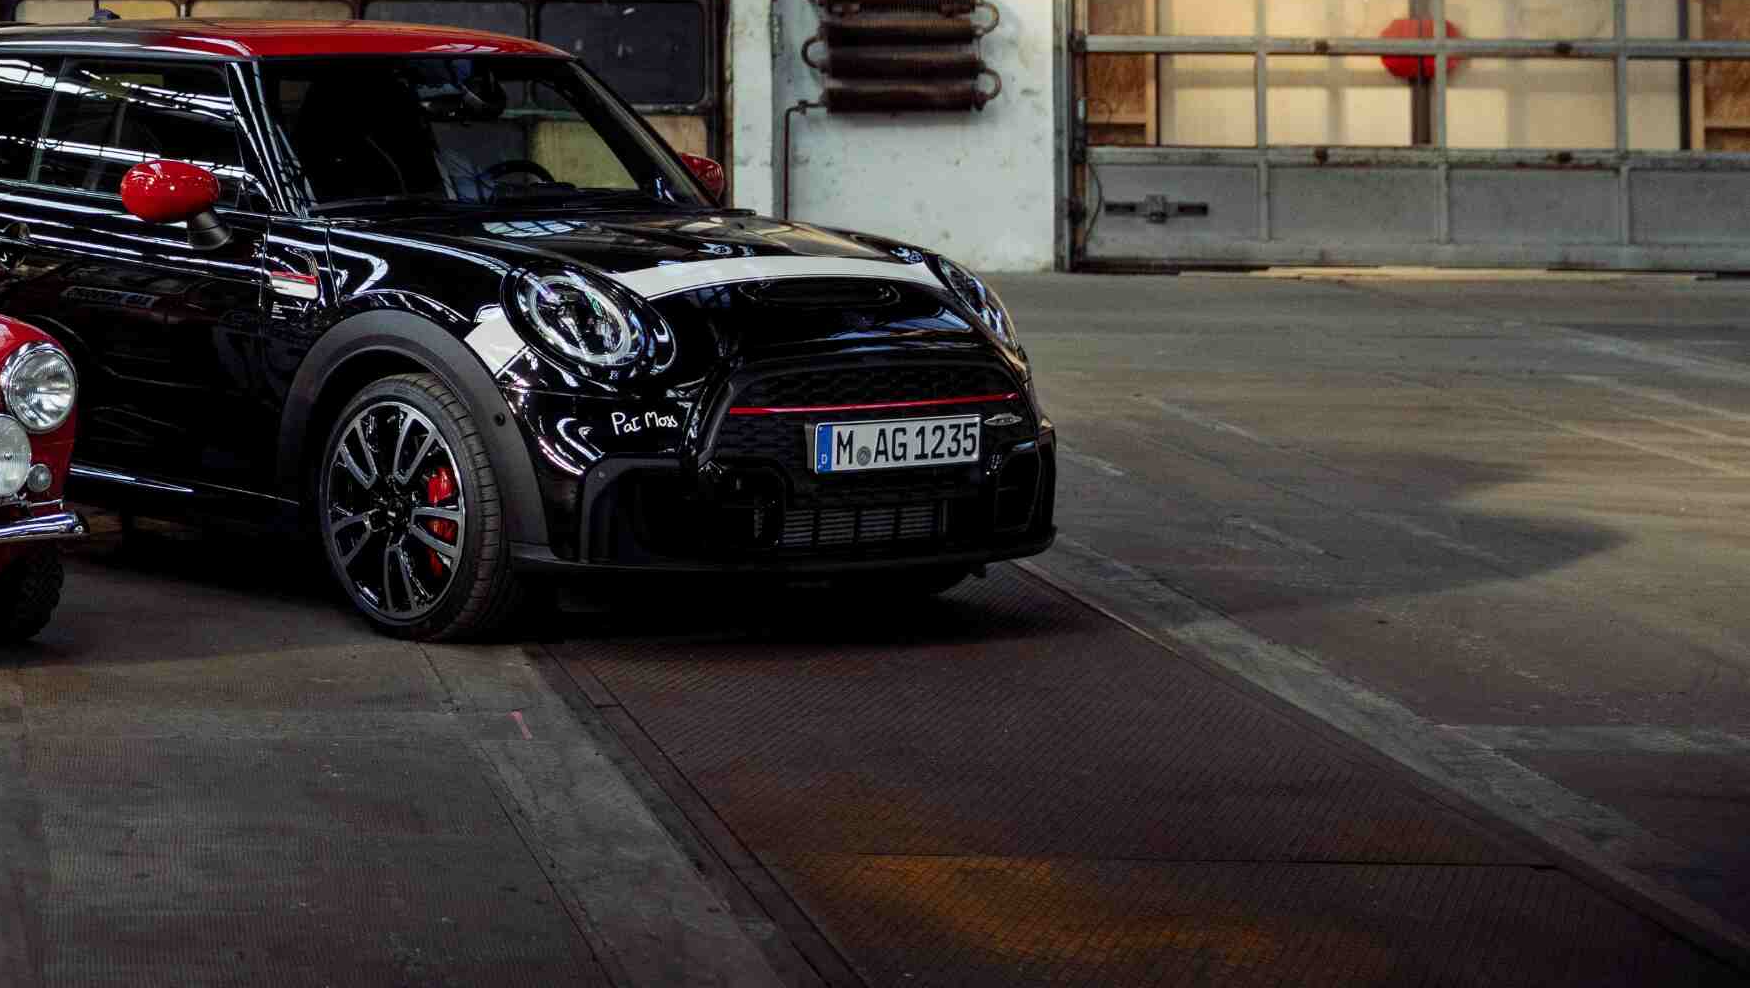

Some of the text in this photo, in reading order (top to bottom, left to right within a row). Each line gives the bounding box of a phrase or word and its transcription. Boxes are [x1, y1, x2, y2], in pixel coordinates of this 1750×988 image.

[611, 411, 678, 436] Pat Moss
[836, 422, 979, 465] M AG 1235
